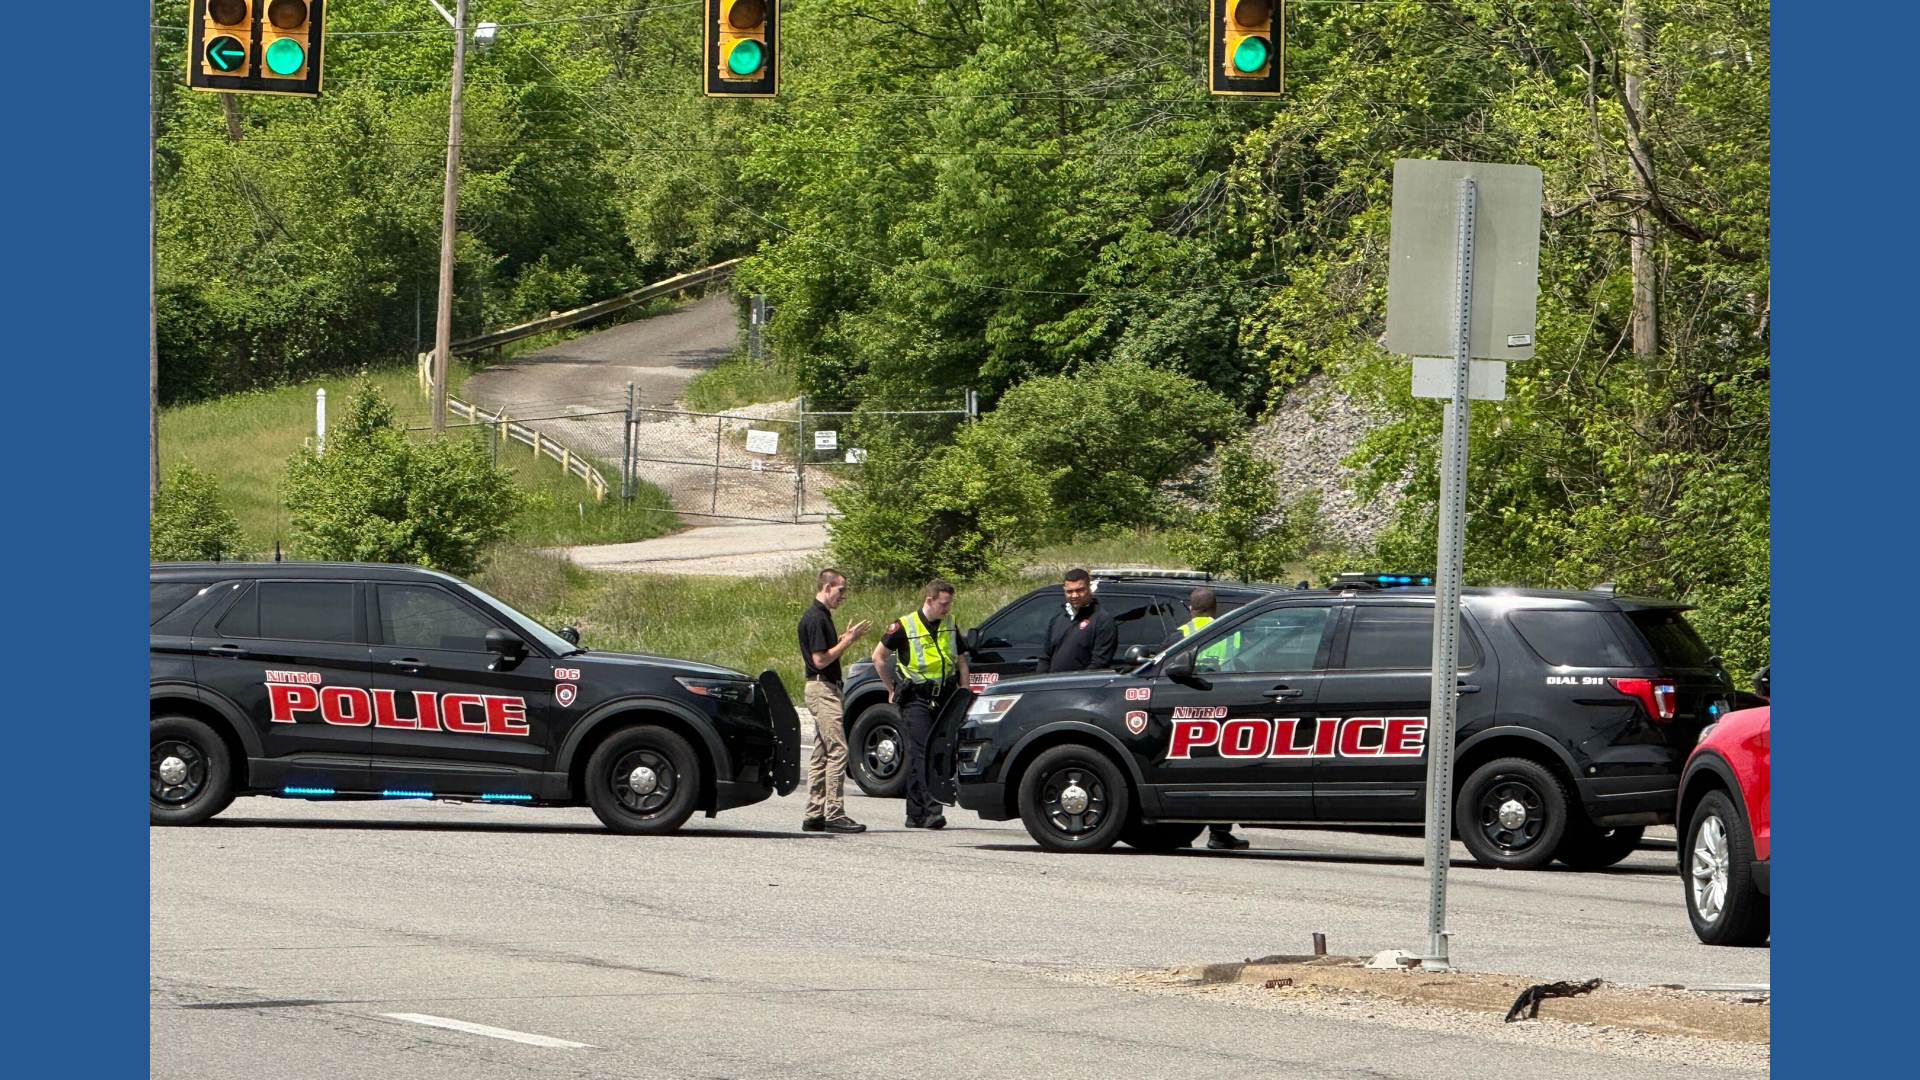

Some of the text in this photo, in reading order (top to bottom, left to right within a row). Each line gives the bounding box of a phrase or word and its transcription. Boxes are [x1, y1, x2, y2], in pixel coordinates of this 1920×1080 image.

[265, 670, 321, 684] NITRO
[554, 668, 581, 680] 06
[1546, 676, 1604, 685] DIAL 911
[1125, 687, 1151, 701] 09
[264, 682, 530, 737] POLICE
[1172, 706, 1228, 718] NITRO
[1165, 716, 1428, 759] POLICE
